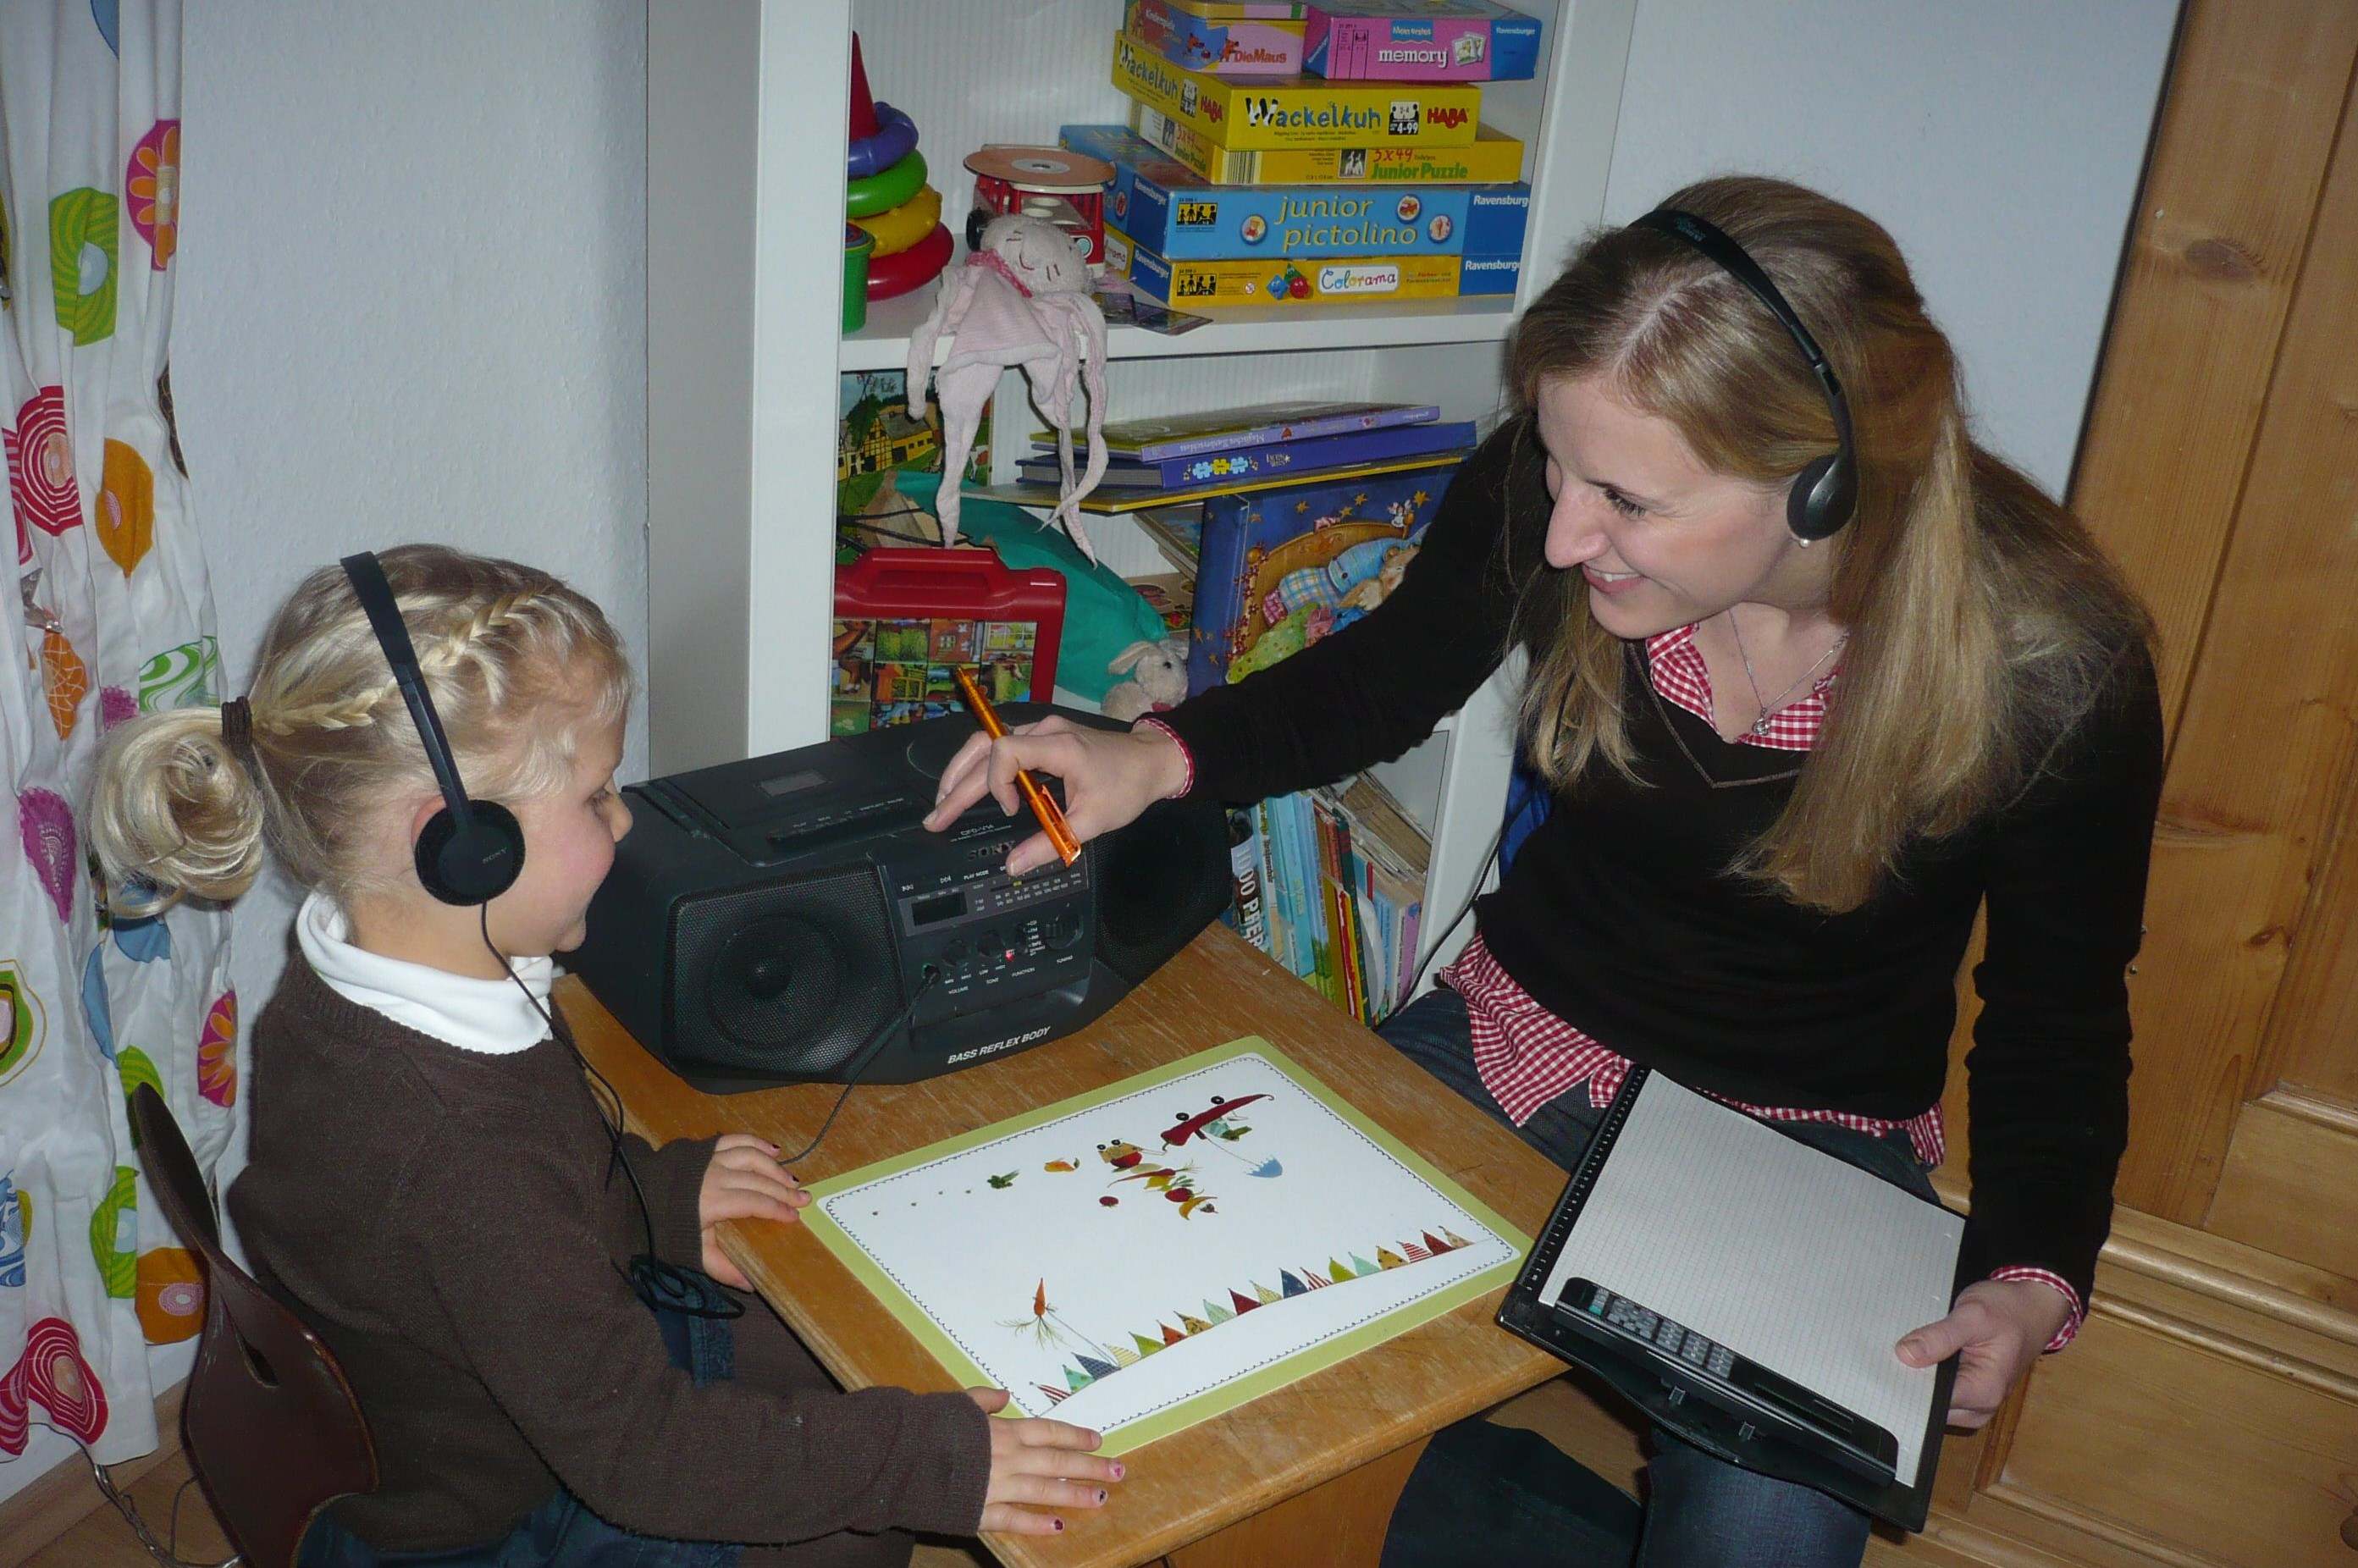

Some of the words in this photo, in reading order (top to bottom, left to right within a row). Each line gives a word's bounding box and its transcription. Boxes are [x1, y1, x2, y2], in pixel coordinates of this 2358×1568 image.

[1496, 26, 1536, 36] Ravensburger
[1378, 47, 1449, 69] memory
[1245, 97, 1381, 129] Wackelkuh
[1427, 107, 1468, 129] HABA
[1397, 122, 1419, 135] 4-99
[1371, 163, 1420, 179] Junior
[1421, 163, 1468, 179] Puzzle
[1277, 195, 1375, 224] junior
[1474, 195, 1530, 207] Ravensburg
[1282, 220, 1418, 253] pictolino
[1321, 268, 1396, 290] Colorama
[967, 841, 1017, 861] SONY
[1236, 847, 1256, 896] 1000
[1242, 897, 1266, 953] PFER
[947, 1049, 979, 1064] BASS
[979, 1035, 1021, 1057] REFLEX
[1021, 1025, 1052, 1043] BODY
